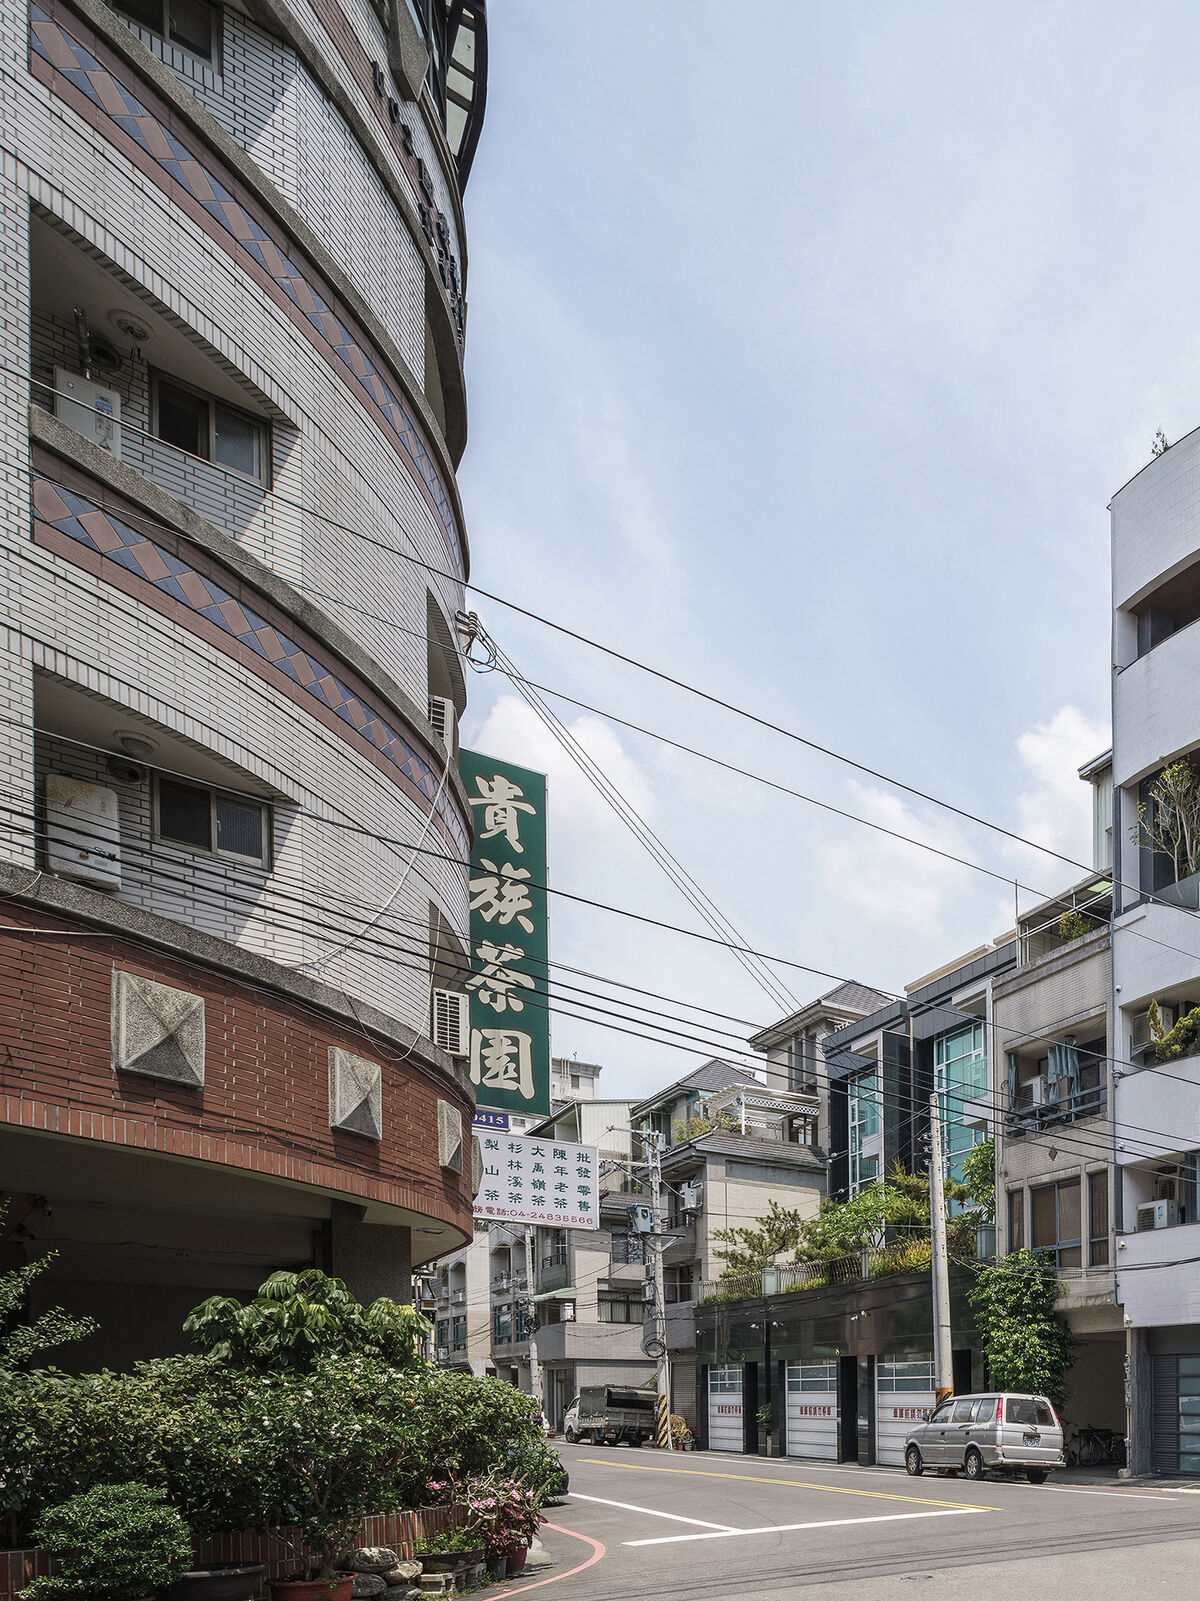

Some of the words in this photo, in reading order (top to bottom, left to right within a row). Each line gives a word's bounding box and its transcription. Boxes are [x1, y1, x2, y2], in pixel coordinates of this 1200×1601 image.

[465, 773, 537, 1100] 貴族茶園
[484, 1138, 500, 1201] 梨山茶
[507, 1142, 523, 1204] 杉林溪茶
[531, 1146, 546, 1207] 大禹嶺茶
[553, 1148, 568, 1209] 陳年老茶
[576, 1152, 591, 1212] 批發零售
